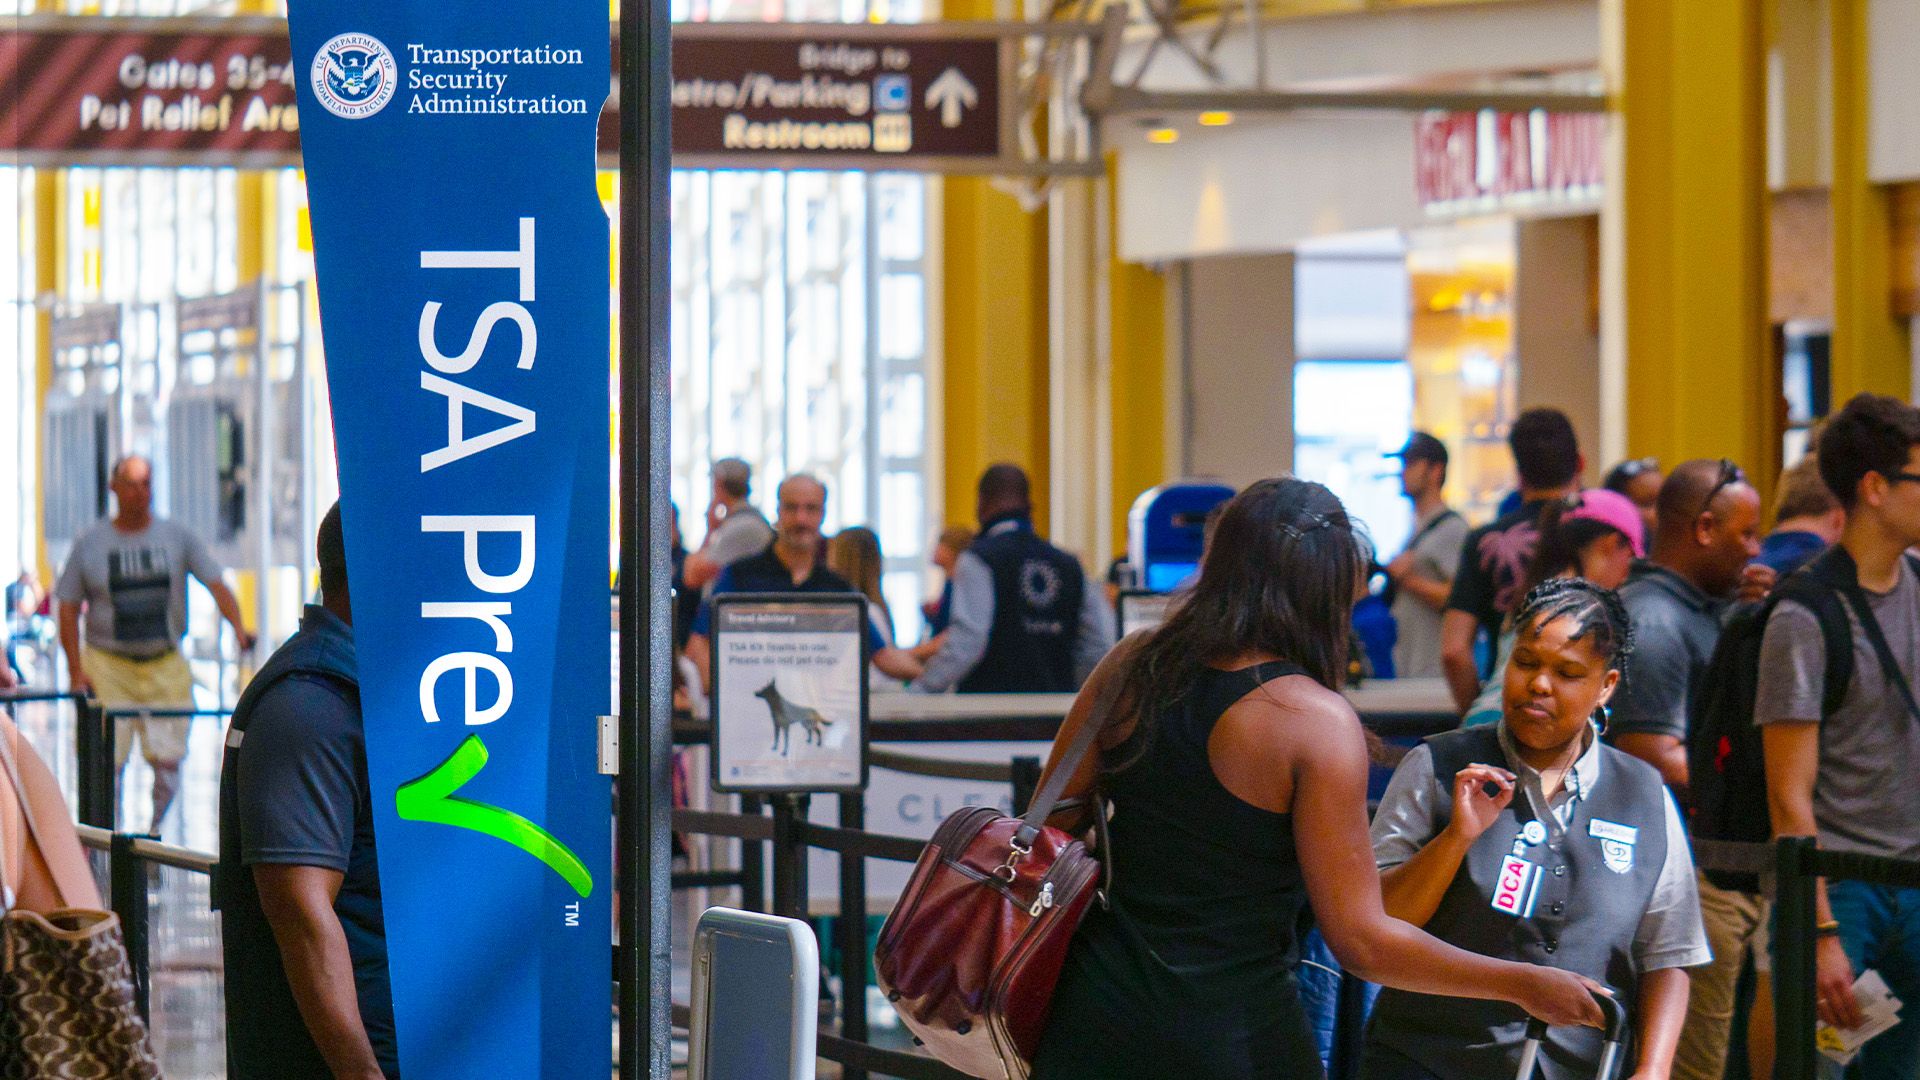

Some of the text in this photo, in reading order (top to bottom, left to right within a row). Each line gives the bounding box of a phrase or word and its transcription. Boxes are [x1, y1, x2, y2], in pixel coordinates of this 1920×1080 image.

[119, 53, 216, 91] Gates
[329, 37, 386, 58] DEPARTMENT
[383, 57, 393, 70] OF
[408, 43, 584, 71] Transportation
[316, 80, 393, 114] HOMELAND SECURITY
[408, 69, 508, 95] Security
[671, 73, 871, 116] etro/Parking
[79, 93, 299, 132] Pet Relief Are
[408, 93, 587, 114] Administration
[723, 112, 872, 149] Restroom
[418, 217, 537, 726] TSA Pre
[1497, 861, 1525, 909] DCA
